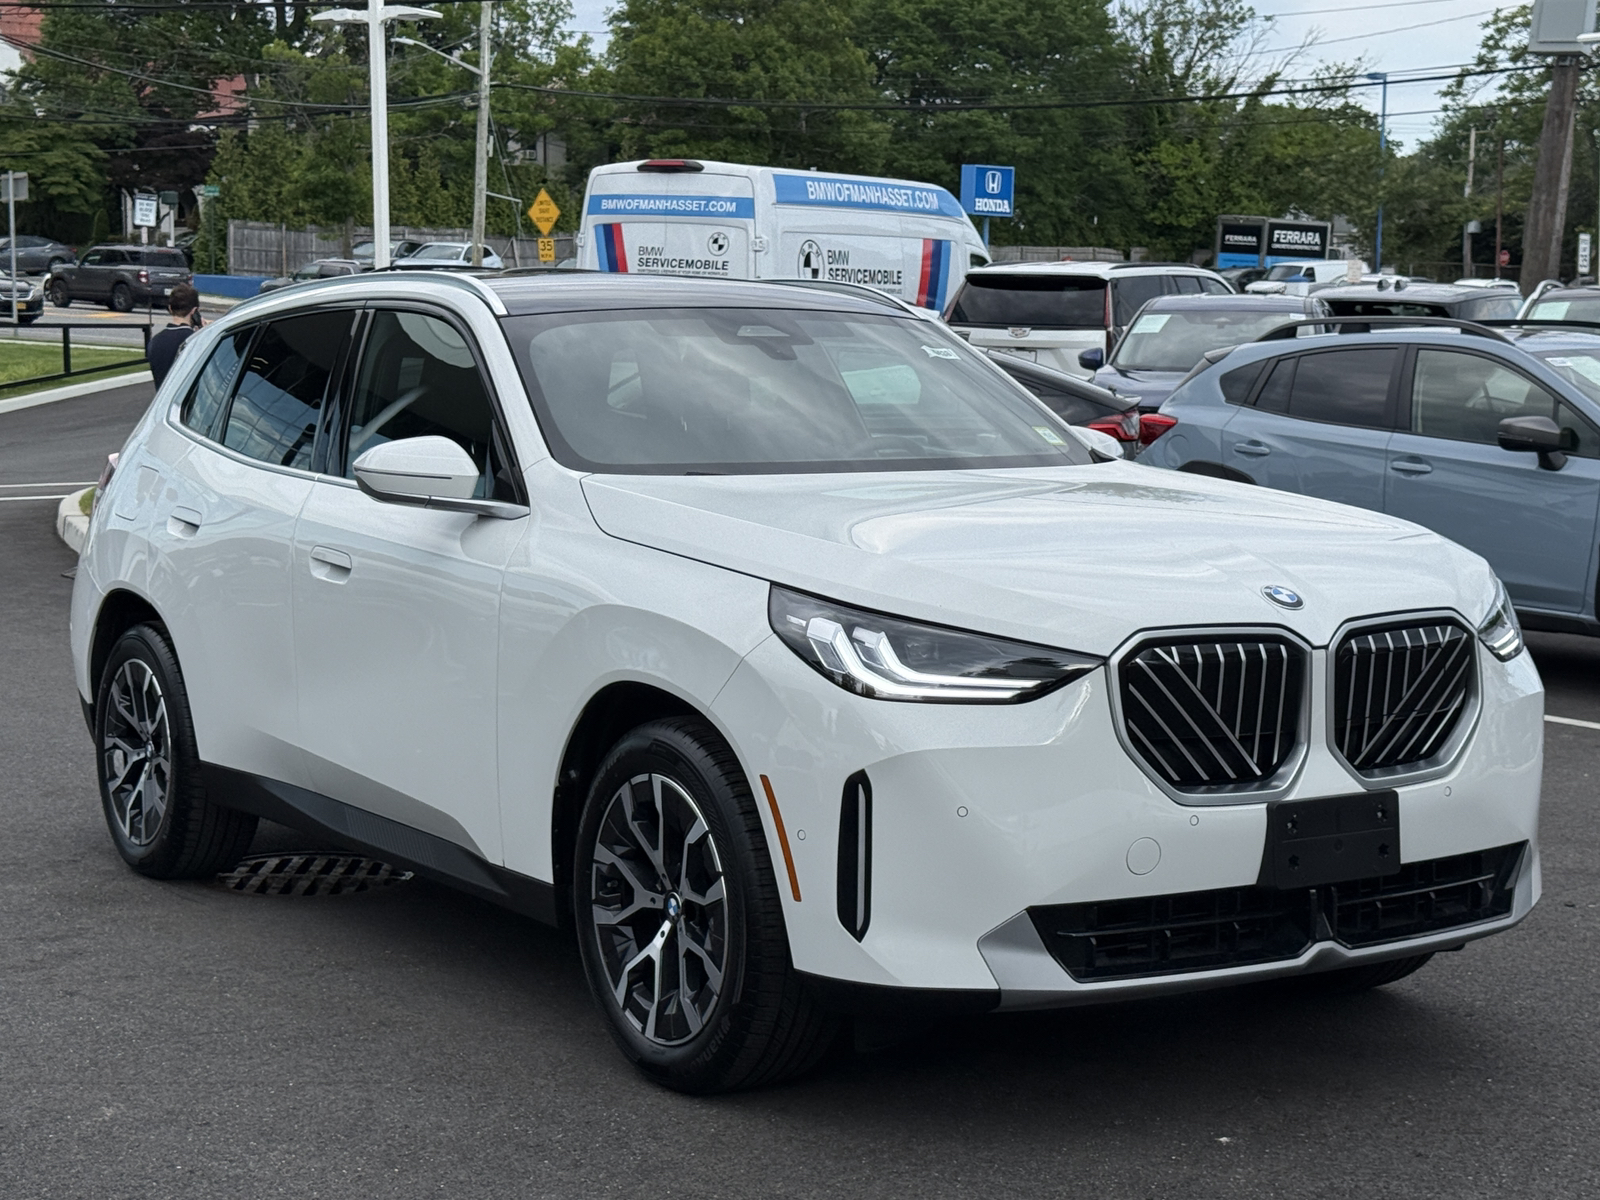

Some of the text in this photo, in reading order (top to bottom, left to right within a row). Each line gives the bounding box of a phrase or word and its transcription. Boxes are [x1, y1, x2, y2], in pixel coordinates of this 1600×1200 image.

[806, 181, 938, 210] BMWOFMANHASSET.COM
[600, 198, 737, 213] BMWOFMANHASSET.COM
[974, 198, 1011, 213] HONDA
[1273, 230, 1321, 244] FERRARA
[539, 240, 553, 251] 35
[637, 245, 665, 257] BMW
[637, 257, 730, 270] SERVICEMOBILE
[827, 249, 850, 266] BMW
[827, 267, 903, 285] SERVICEMOBILE
